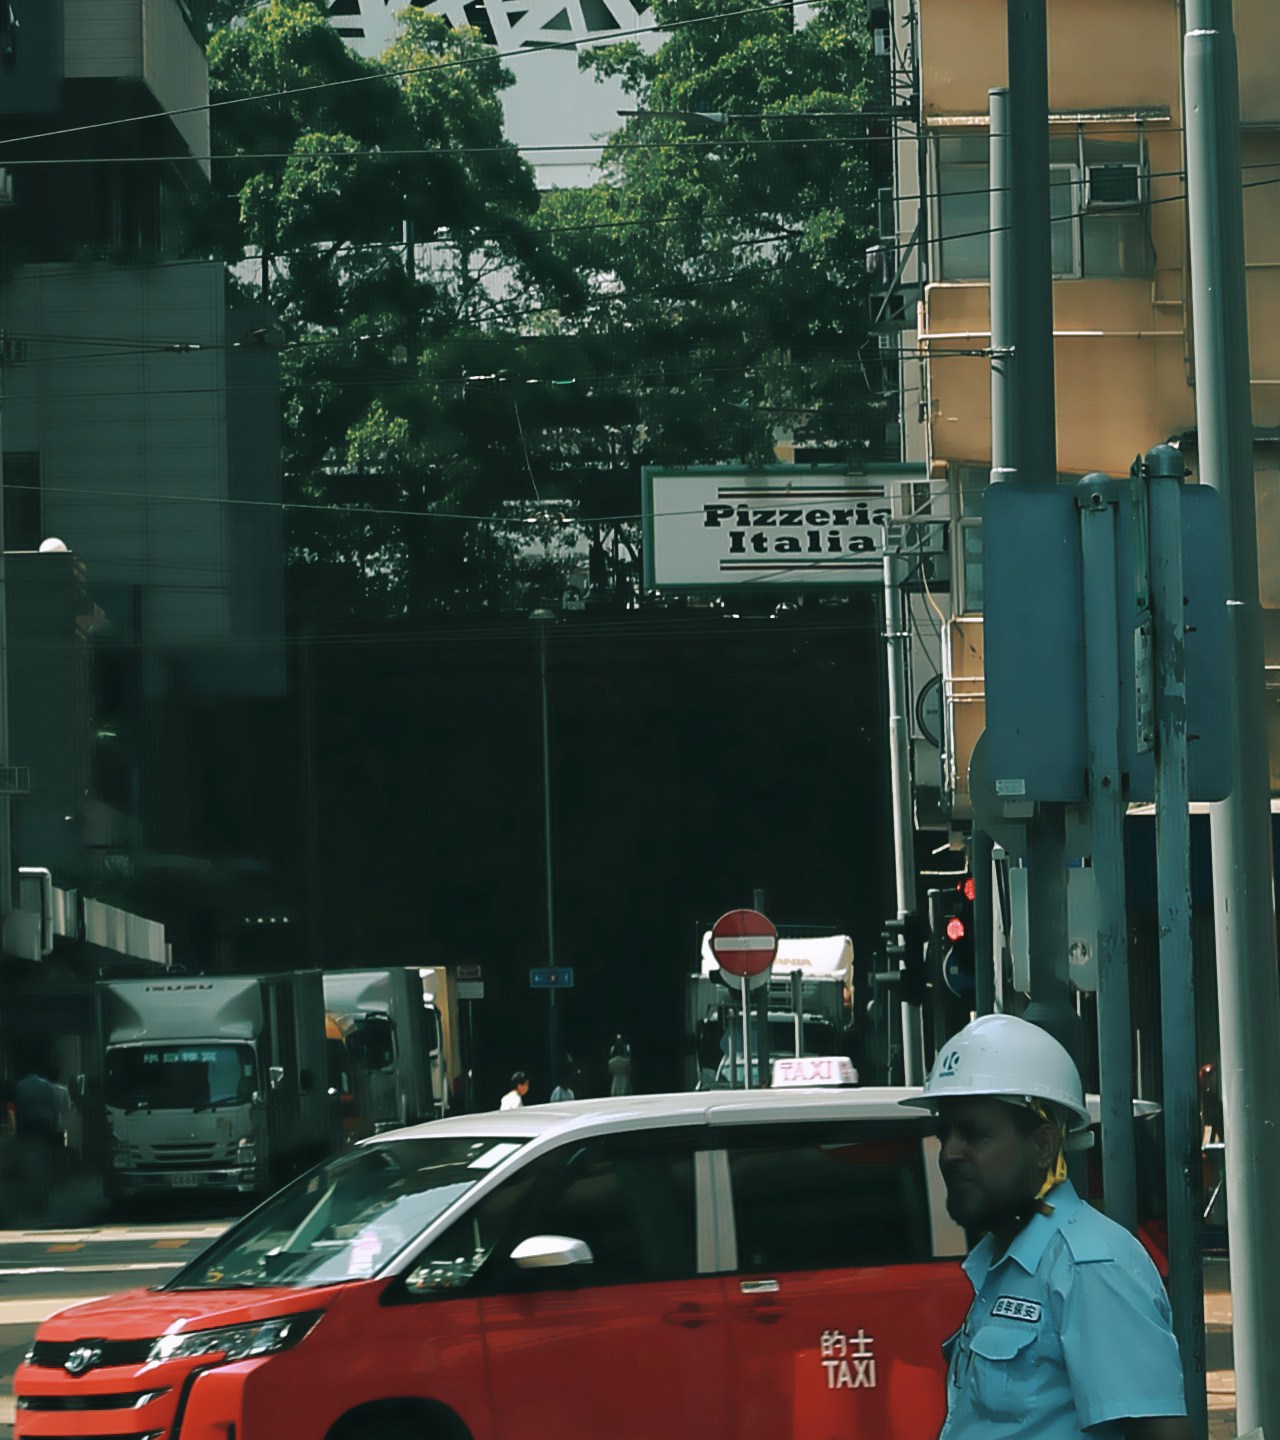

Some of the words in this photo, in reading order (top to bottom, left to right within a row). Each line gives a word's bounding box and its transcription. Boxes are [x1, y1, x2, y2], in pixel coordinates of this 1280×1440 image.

[704, 503, 890, 526] Pizzeria
[730, 531, 876, 552] Italia
[781, 1061, 833, 1081] TAXI
[820, 1329, 874, 1359] 的士
[822, 1359, 877, 1389] TAXI
